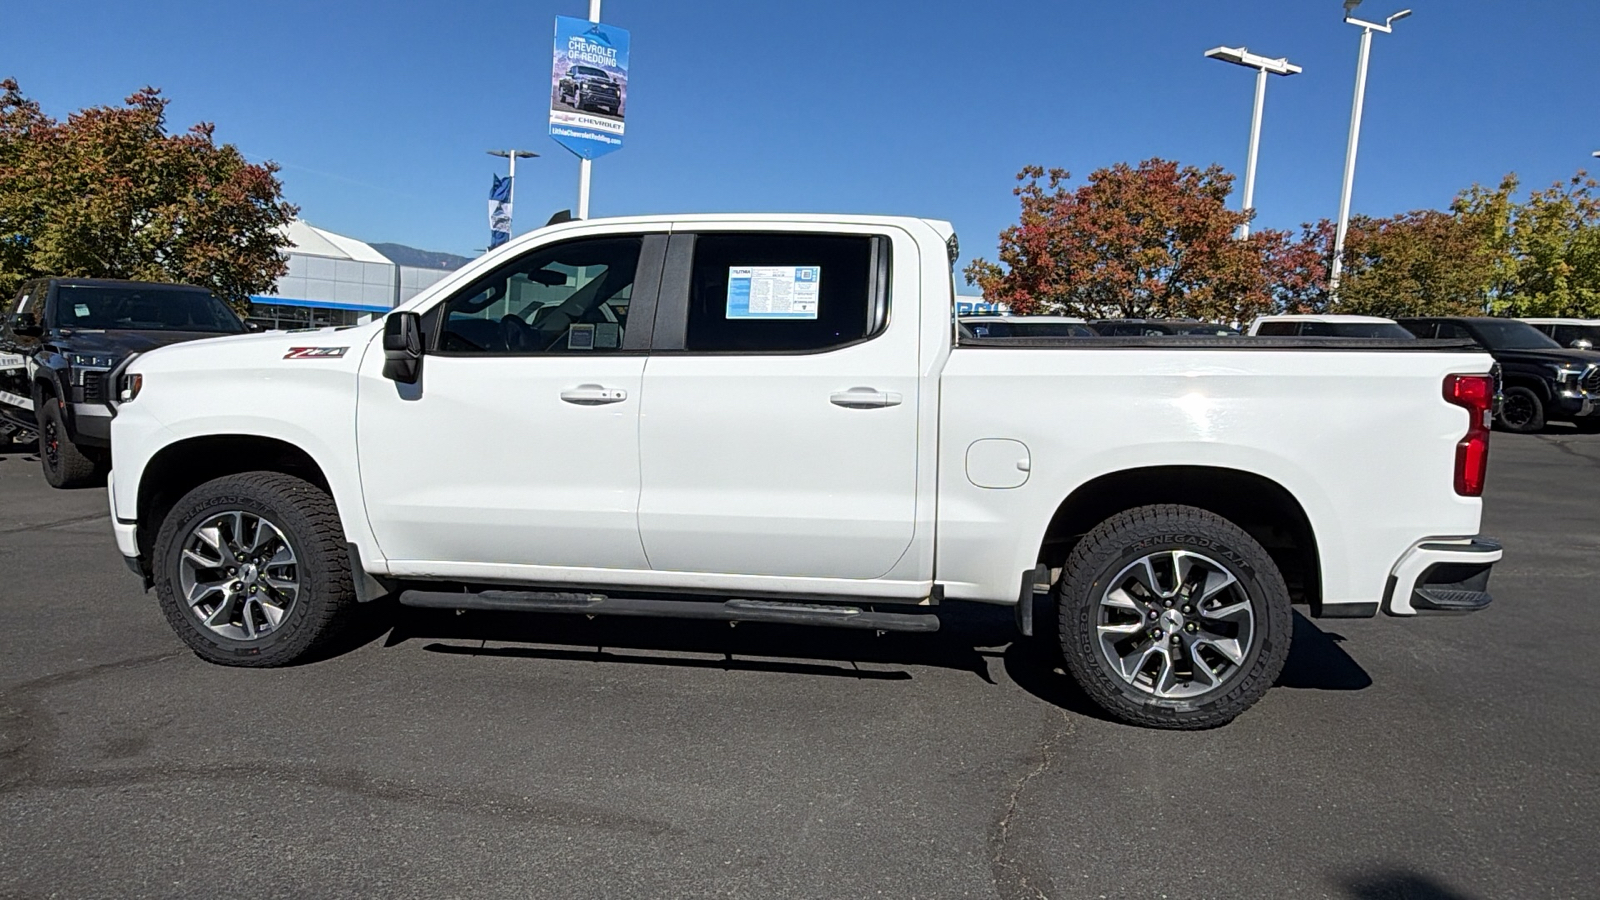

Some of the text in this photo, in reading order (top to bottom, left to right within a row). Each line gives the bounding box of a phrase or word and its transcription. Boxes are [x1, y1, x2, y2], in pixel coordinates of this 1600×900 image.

[568, 41, 617, 58] CHEVROLET
[568, 50, 617, 67] OF REDDING
[578, 117, 622, 129] CHEVROLET
[183, 496, 271, 523] RENEGADE A/T
[1131, 533, 1250, 569] RENEGADE A/T
